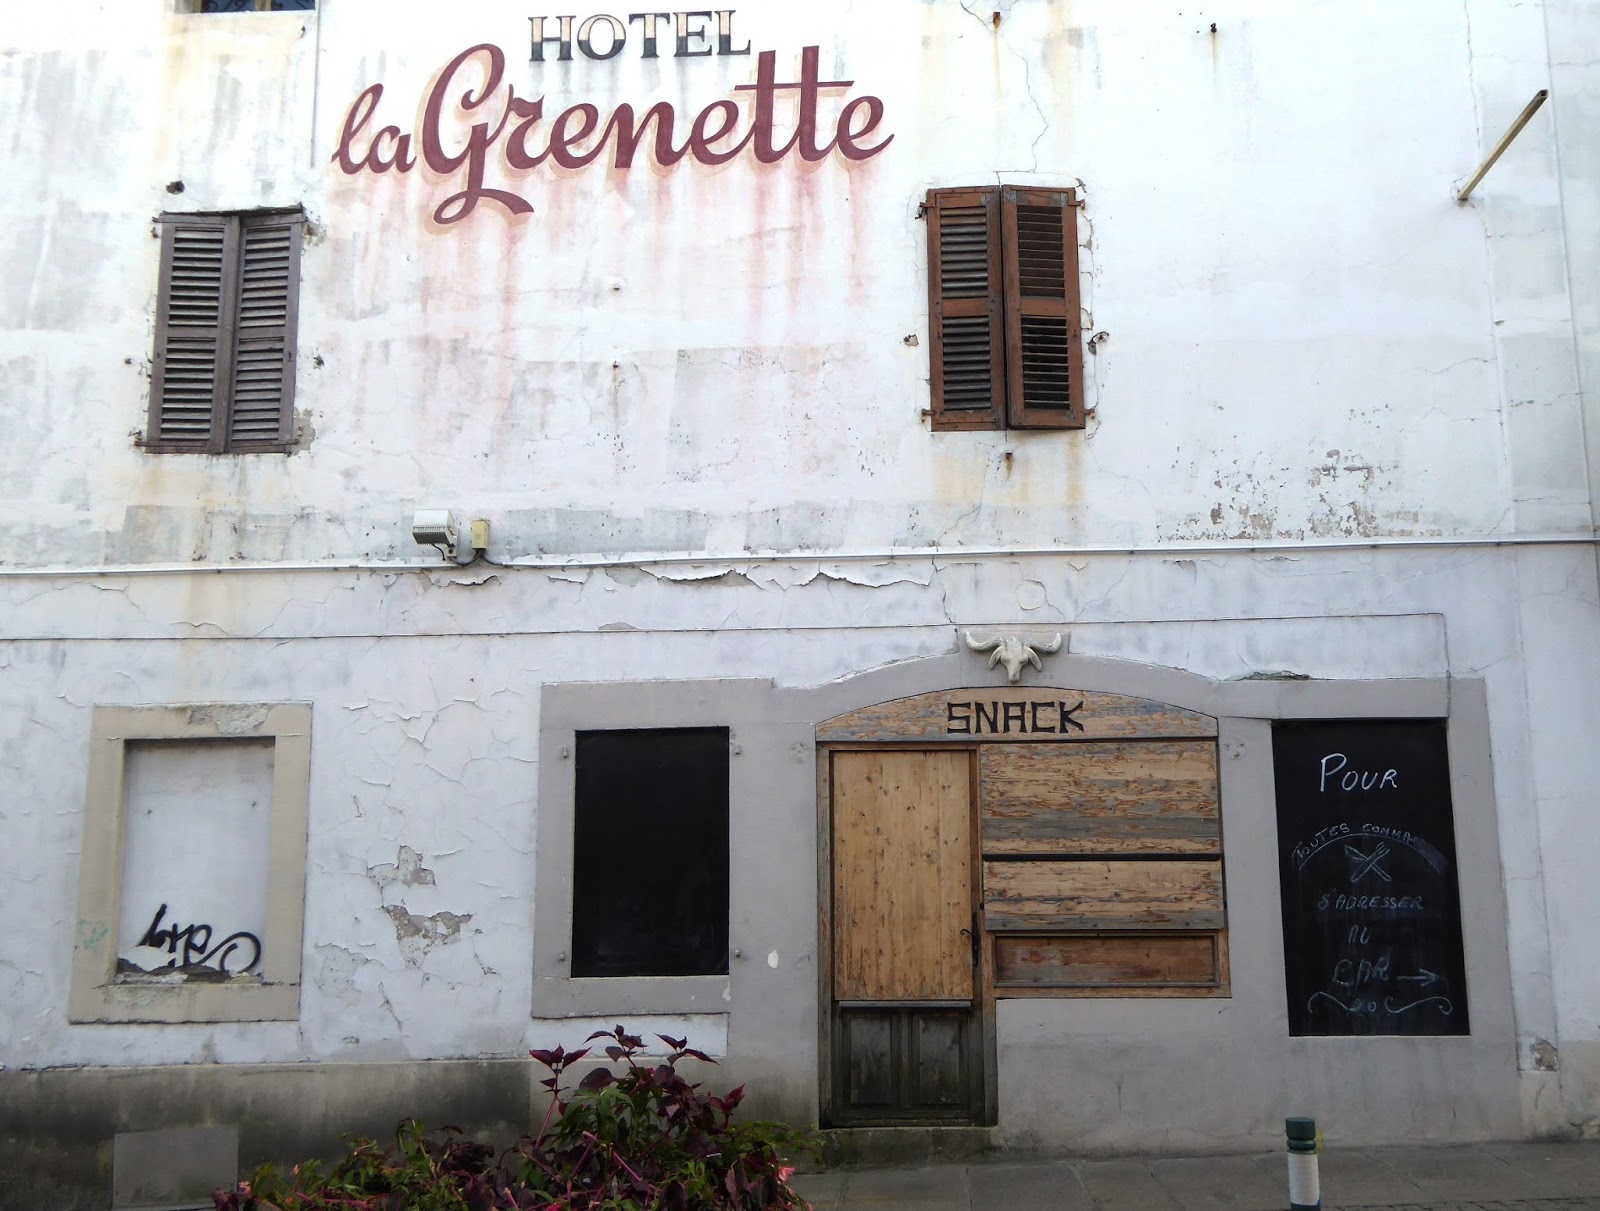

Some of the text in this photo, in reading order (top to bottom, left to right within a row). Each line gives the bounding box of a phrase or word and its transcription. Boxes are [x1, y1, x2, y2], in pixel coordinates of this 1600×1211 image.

[528, 10, 751, 62] HOTEL
[331, 43, 895, 225] la Grenette
[946, 701, 1084, 734] SNACK
[1320, 752, 1398, 792] POUR
[1294, 823, 1350, 859] TOUTES
[1348, 925, 1371, 945] AU
